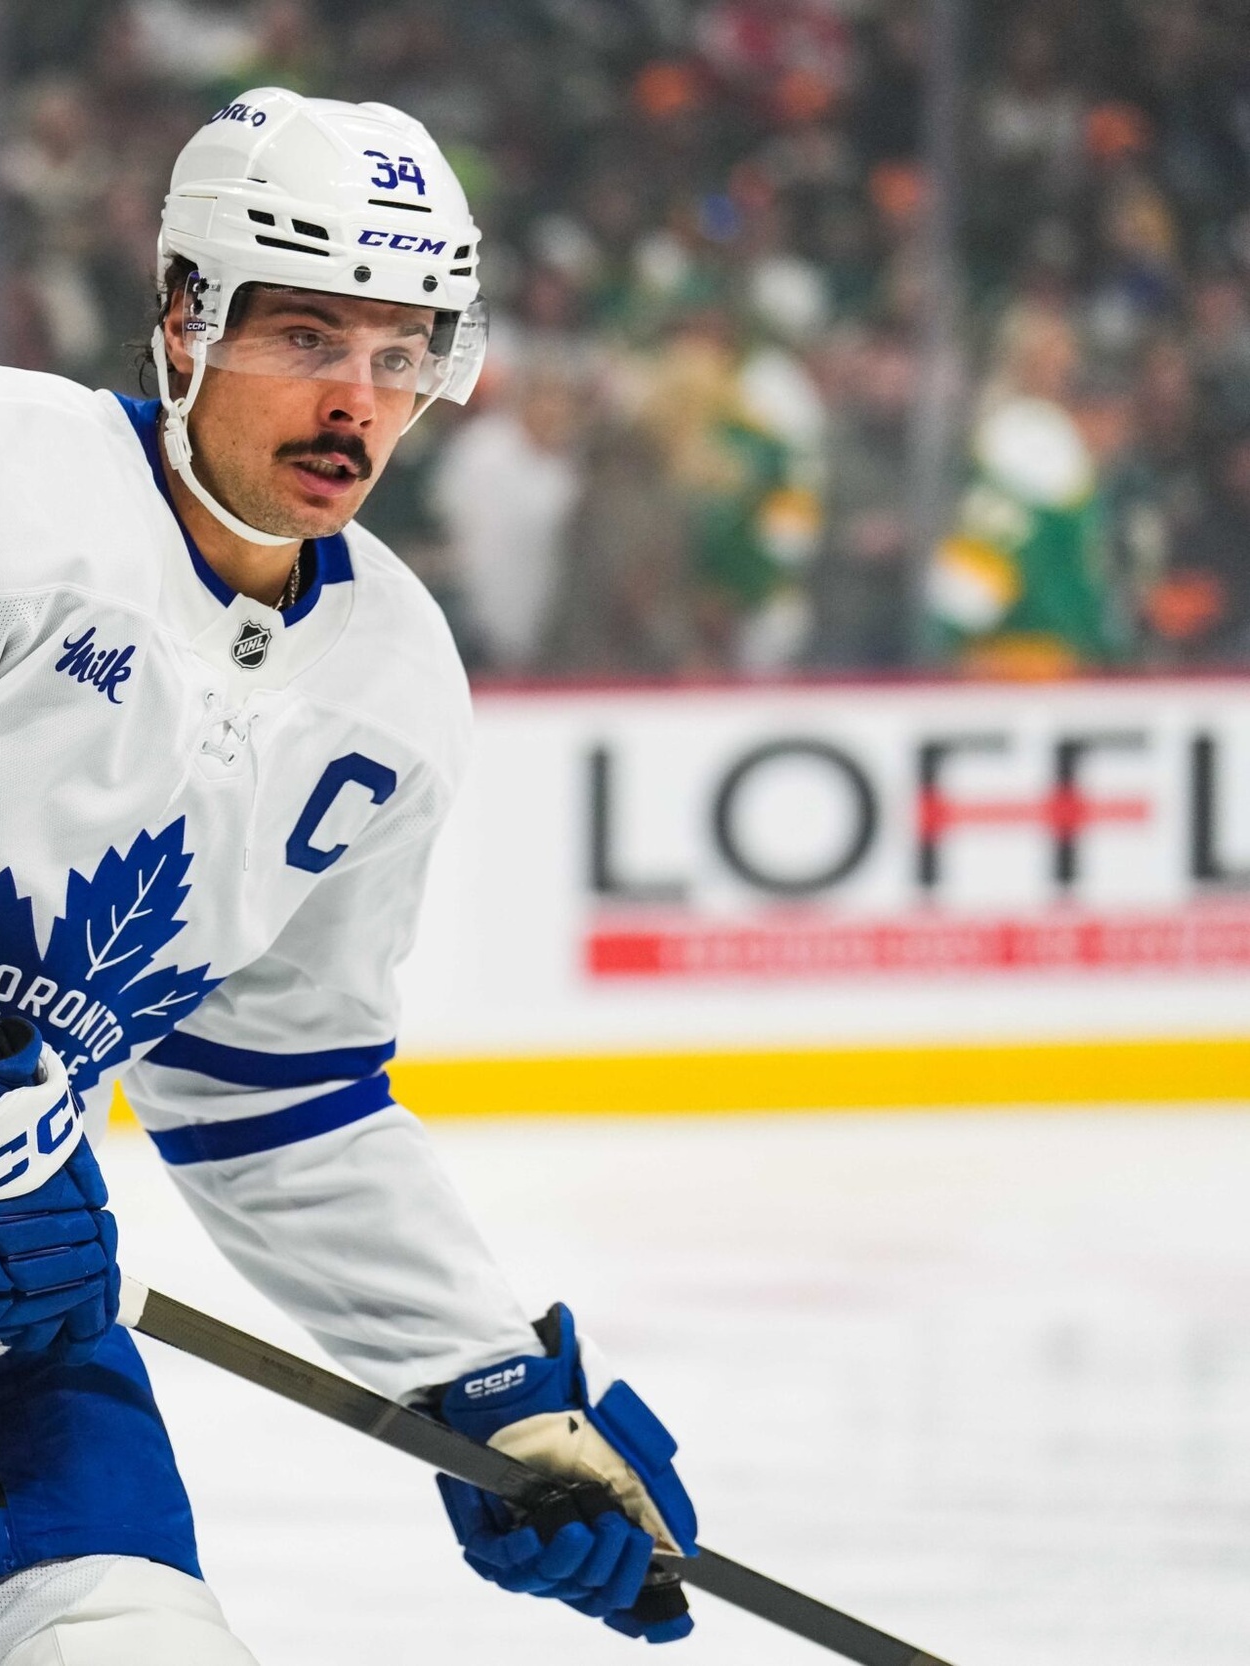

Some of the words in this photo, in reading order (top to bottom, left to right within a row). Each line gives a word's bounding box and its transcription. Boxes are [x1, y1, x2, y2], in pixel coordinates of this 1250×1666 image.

[363, 150, 426, 195] 34
[357, 229, 447, 255] CCM
[187, 322, 206, 330] CCM
[55, 626, 136, 704] Milk
[236, 636, 265, 656] NHL
[285, 752, 397, 874] C
[587, 730, 1250, 902] LOFFL
[465, 1363, 526, 1394] CCM
